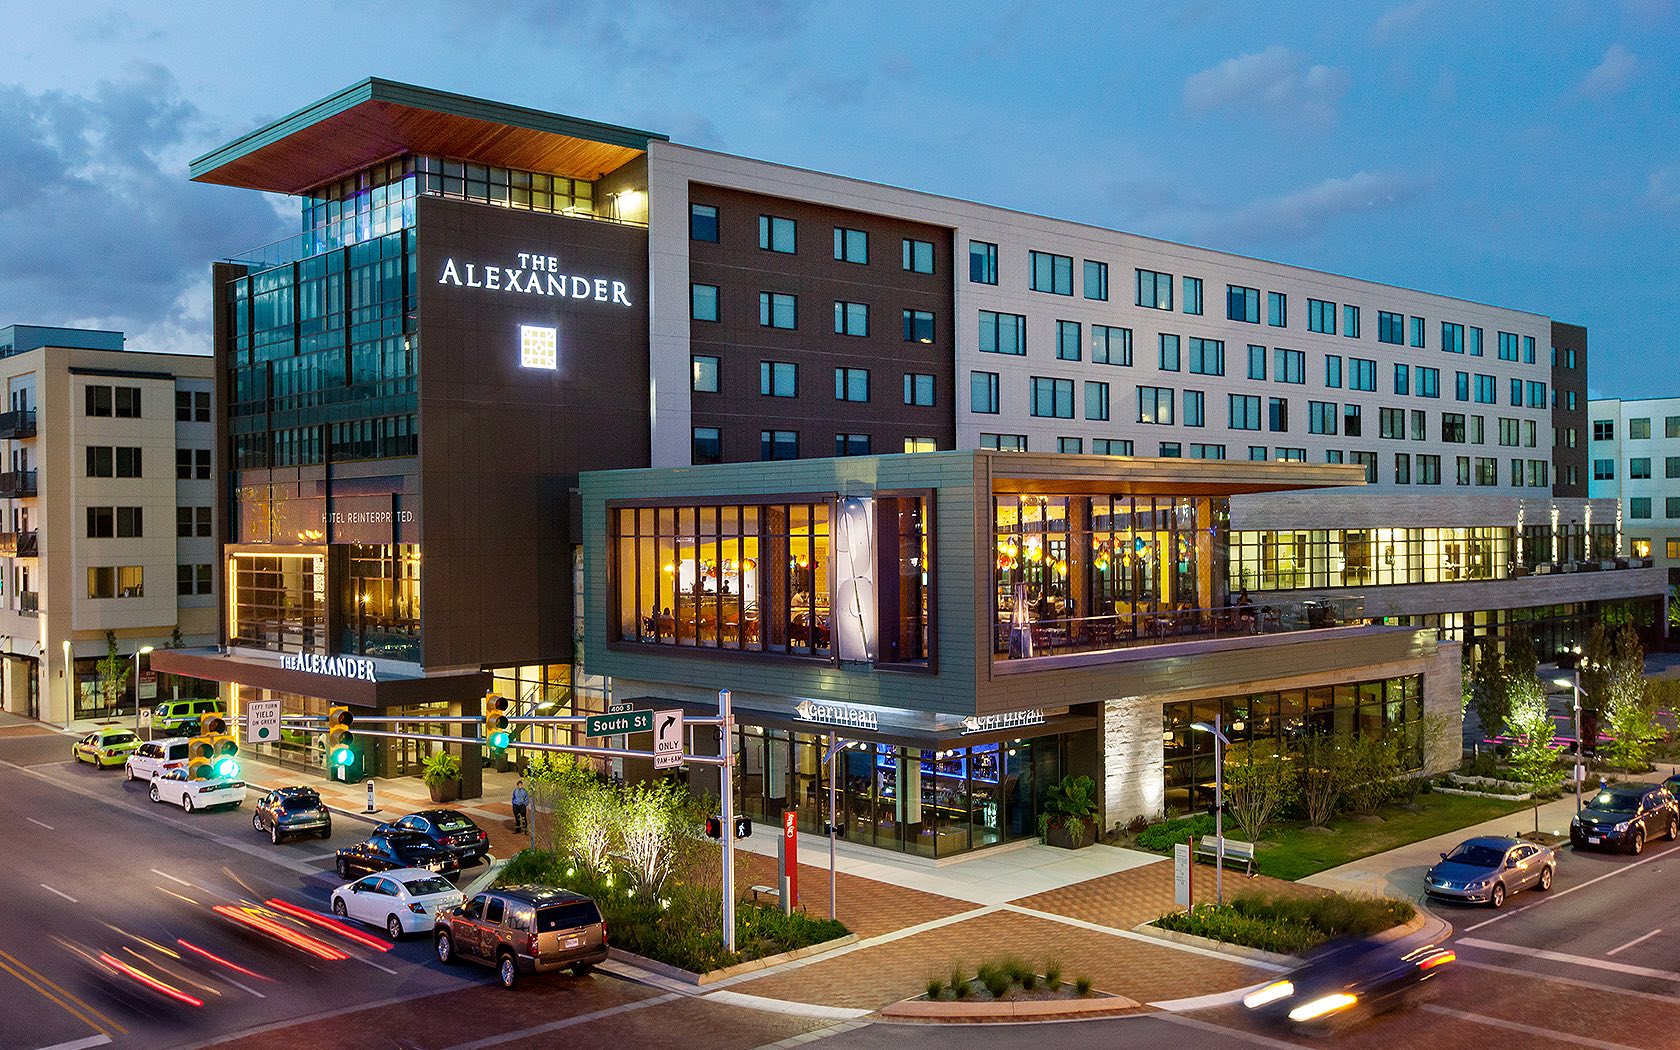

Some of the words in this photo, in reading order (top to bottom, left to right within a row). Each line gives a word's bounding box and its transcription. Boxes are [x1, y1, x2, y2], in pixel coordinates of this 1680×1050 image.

[517, 252, 558, 273] THE
[438, 257, 632, 307] ALEXANDER
[347, 510, 415, 523] REINTERPRTED.
[279, 655, 296, 670] THE
[296, 649, 377, 684] ALEXANDER
[255, 710, 274, 718] YIELD
[808, 703, 878, 723] cerulean
[593, 717, 629, 732] South
[633, 715, 647, 728] St
[658, 740, 679, 751] ONLY
